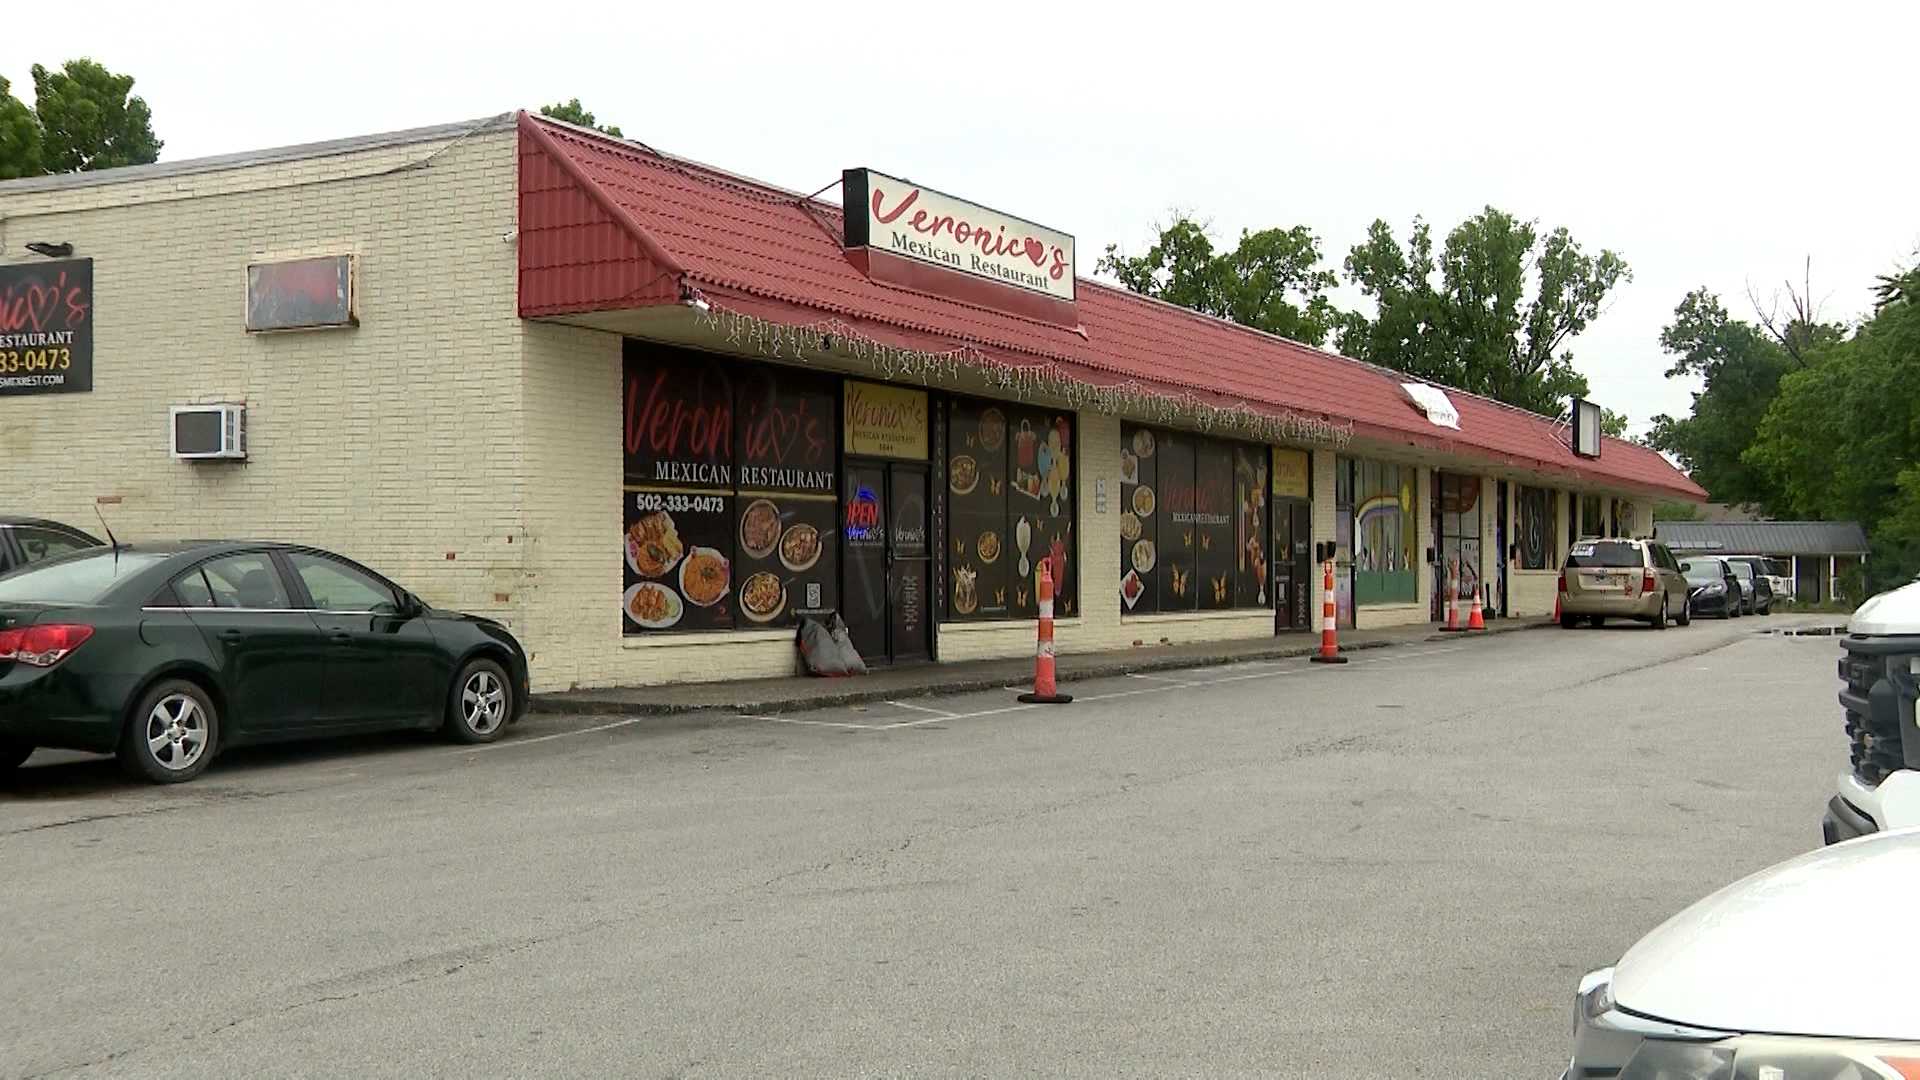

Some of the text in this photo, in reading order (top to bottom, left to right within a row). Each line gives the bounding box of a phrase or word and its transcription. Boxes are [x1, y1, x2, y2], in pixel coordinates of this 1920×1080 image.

[891, 231, 1049, 290] Mexican Restaurant
[655, 461, 834, 490] MEXICAN RESTAURANT
[636, 493, 724, 513] 502-333-0473
